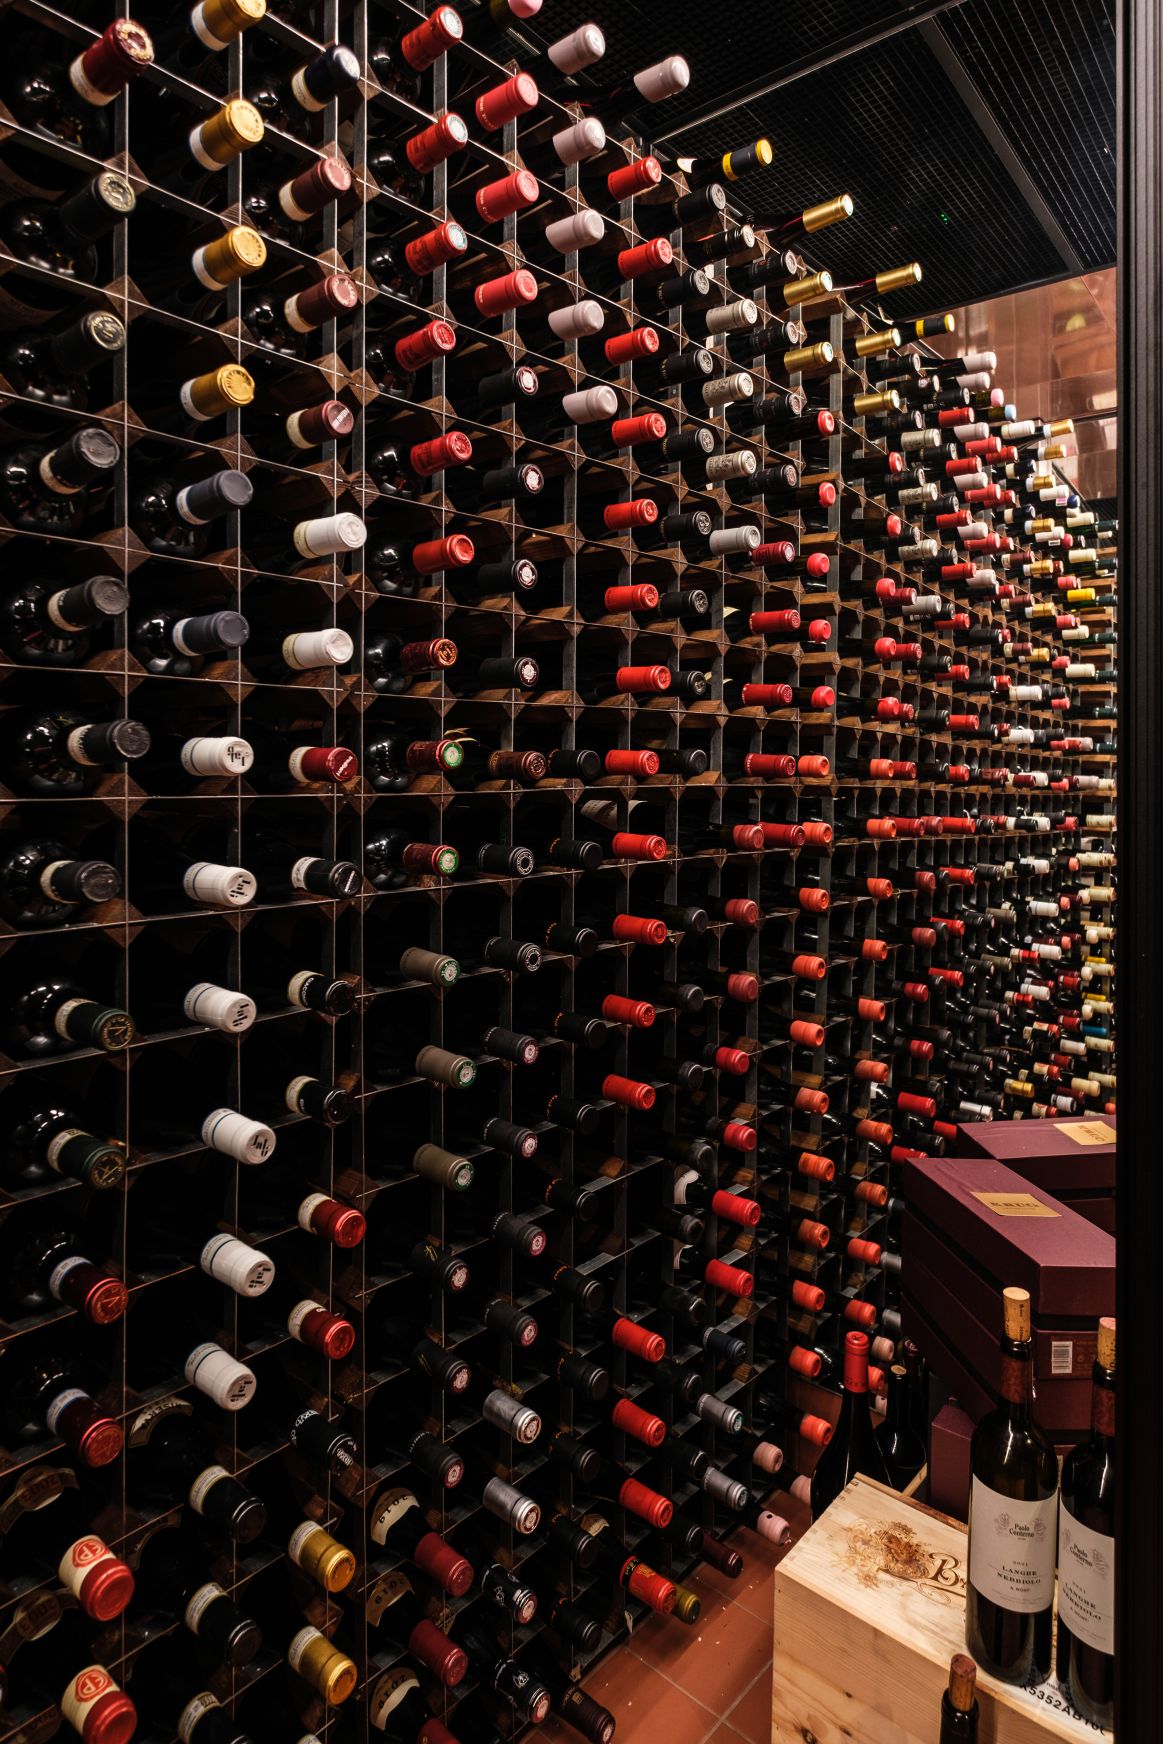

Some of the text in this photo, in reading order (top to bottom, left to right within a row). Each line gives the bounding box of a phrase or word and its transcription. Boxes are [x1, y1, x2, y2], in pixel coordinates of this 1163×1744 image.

[1014, 1523, 1030, 1532] Paolo
[1002, 1565, 1037, 1576] LANGHE
[997, 1572, 1041, 1585] NEBBIOLO
